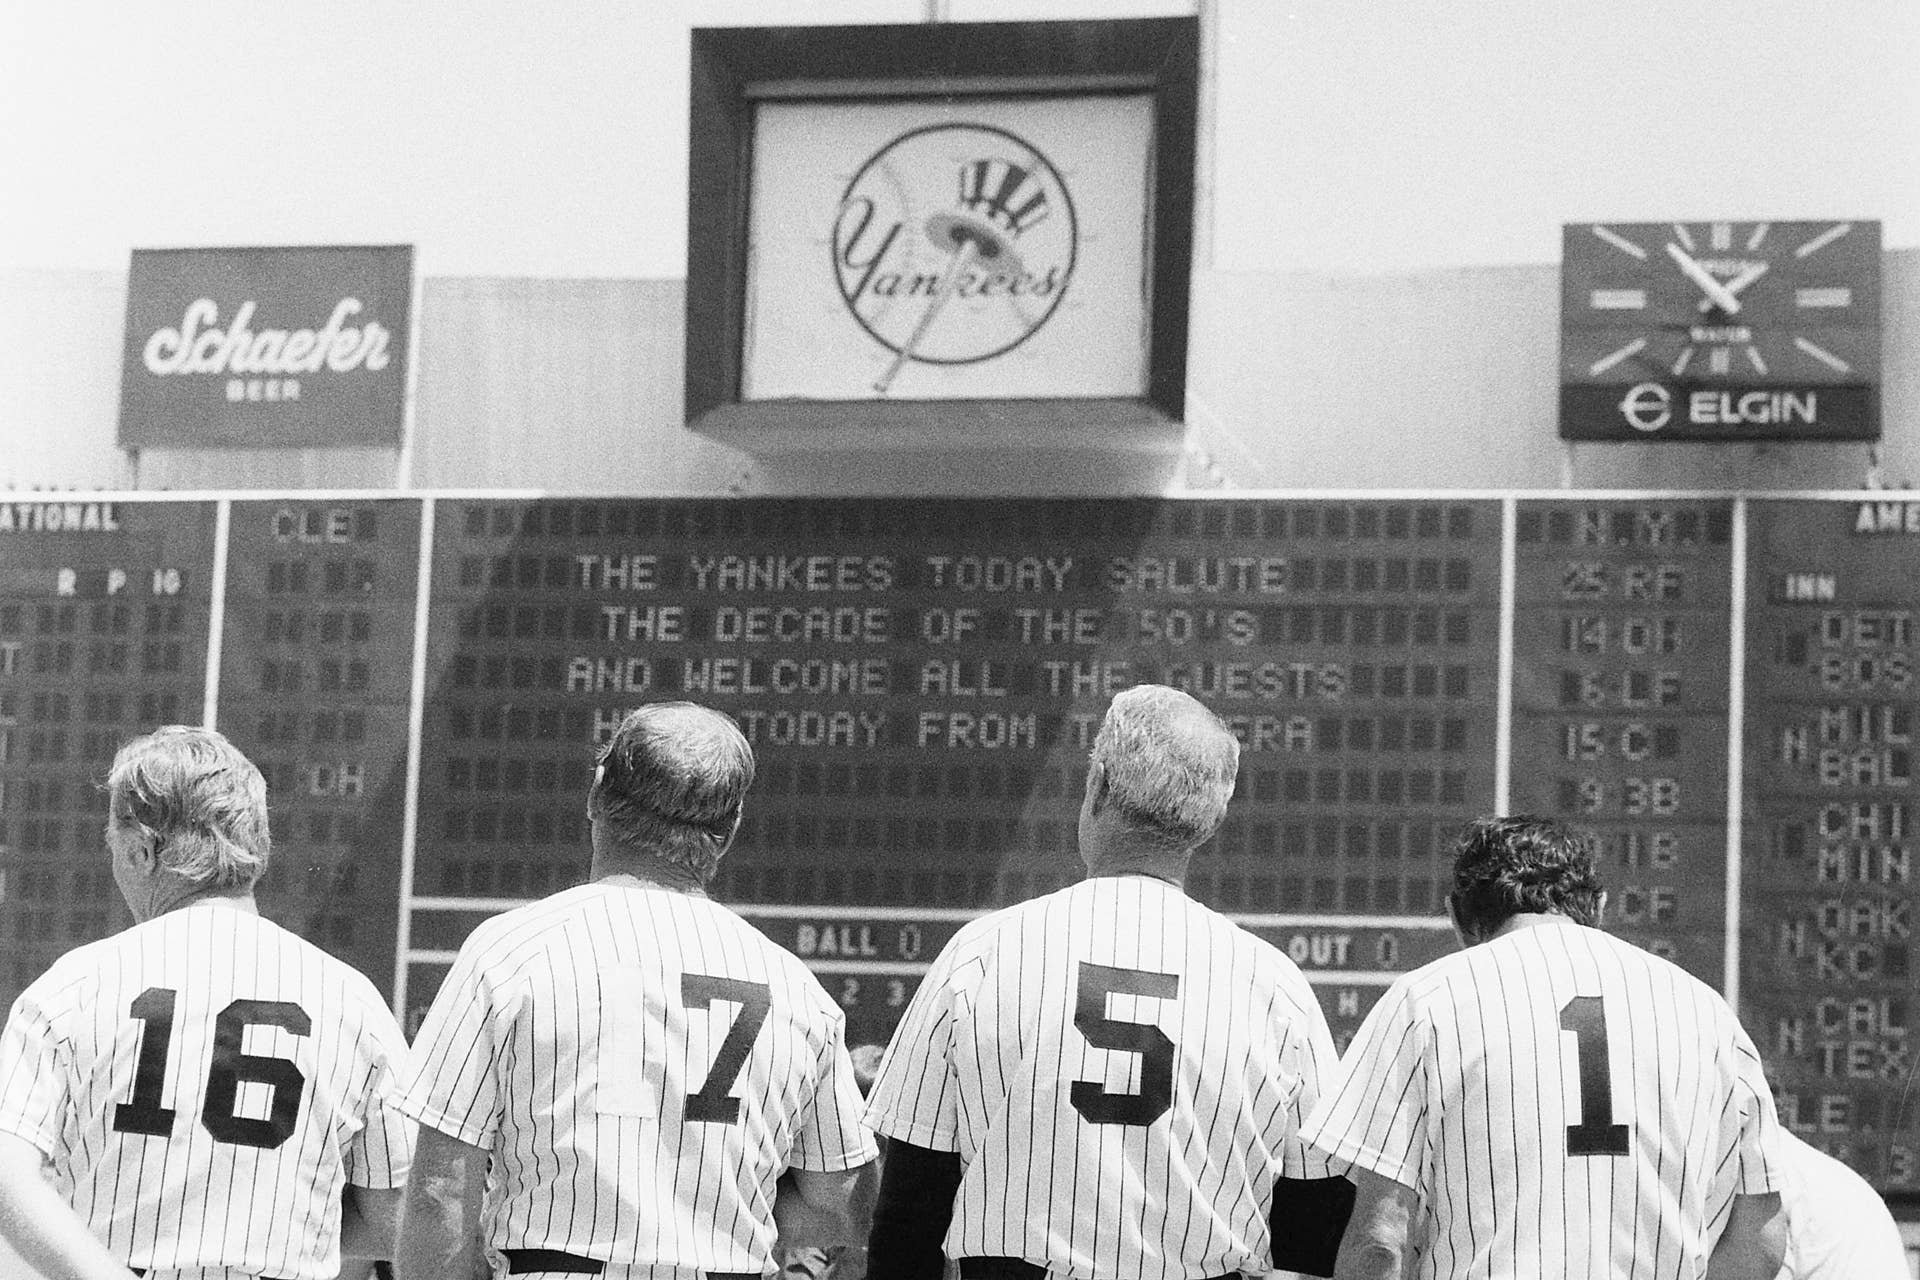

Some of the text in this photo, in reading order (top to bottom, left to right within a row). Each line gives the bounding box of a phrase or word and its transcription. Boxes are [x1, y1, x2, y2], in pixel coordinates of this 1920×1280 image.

[143, 297, 390, 375] Schaefer
[1690, 392, 1816, 424] ELGIN
[272, 508, 350, 543] CLE
[576, 554, 1288, 593] THE YANKEES TODAY SALUTE
[1624, 563, 1683, 600] RF
[602, 606, 1256, 646] THE DECADE OF THE 50'S
[1821, 610, 1912, 648] DET
[567, 657, 651, 694] AND
[684, 658, 888, 694] WELCOME
[921, 659, 1006, 697] ALL
[1042, 660, 1129, 697] THE
[1622, 670, 1681, 708] LF
[1821, 651, 1913, 691] BOS
[741, 709, 887, 747] TODAY
[918, 711, 1036, 749] FROM
[1567, 722, 1605, 761] 15
[1820, 704, 1911, 744] MIL
[1819, 748, 1911, 787] BAL
[1625, 777, 1680, 815] 3B
[1819, 802, 1902, 841] CHI
[1818, 845, 1911, 884] MIN
[797, 925, 876, 957] BALL
[1288, 933, 1350, 966] OUT
[841, 977, 905, 1007] 2 3
[681, 973, 770, 1125] 7
[1070, 961, 1179, 1126] 5
[1816, 1040, 1908, 1079] TEX
[113, 987, 312, 1149] 16
[1560, 995, 1629, 1157] 1
